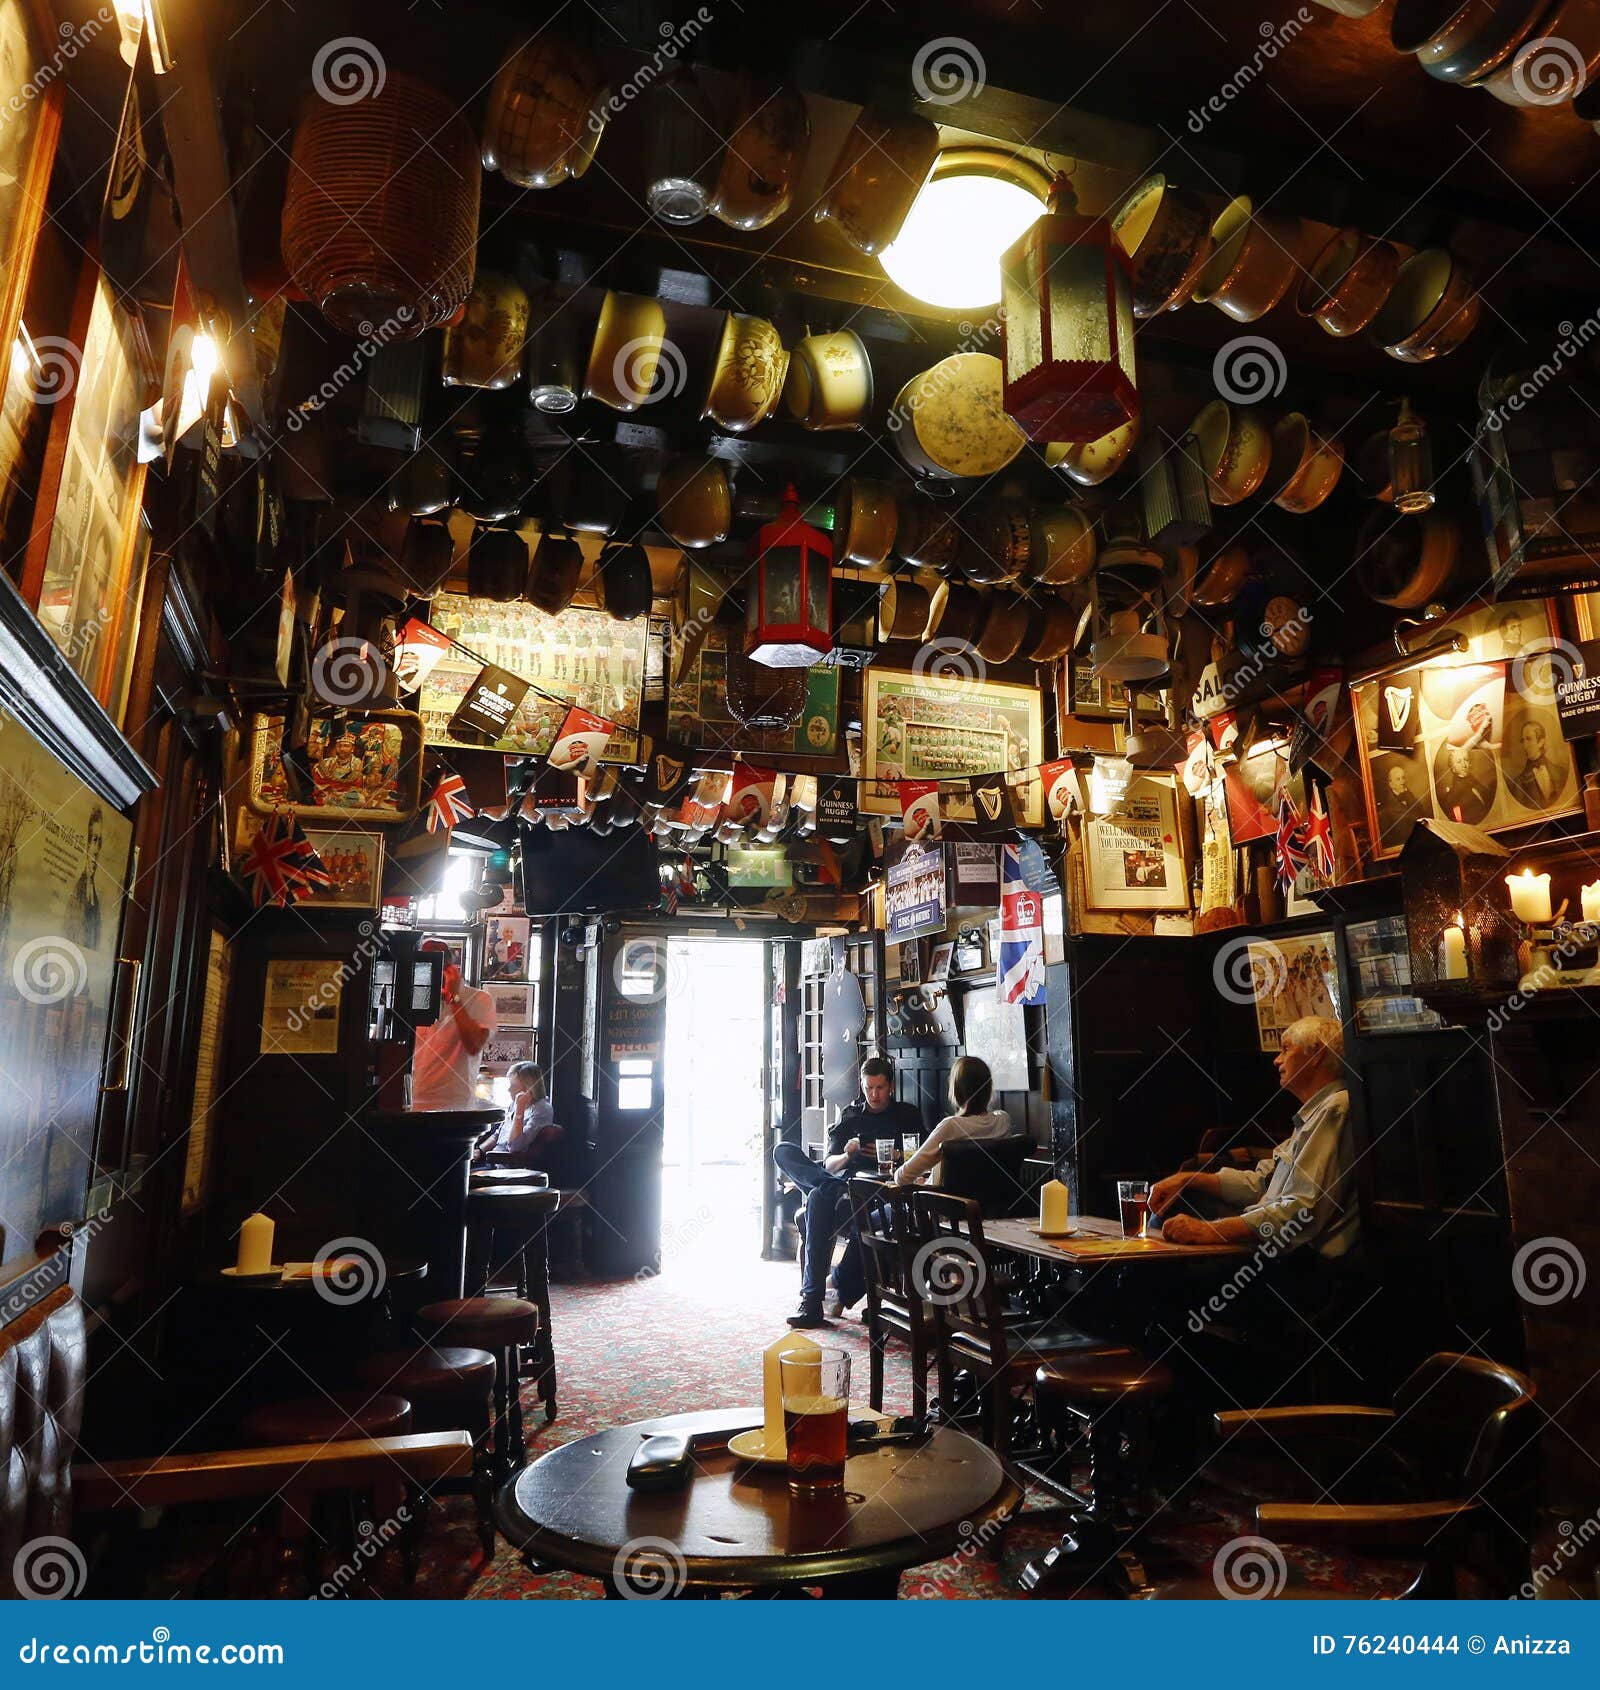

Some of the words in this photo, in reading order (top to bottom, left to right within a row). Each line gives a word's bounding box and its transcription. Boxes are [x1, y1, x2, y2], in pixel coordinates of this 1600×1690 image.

[1557, 676, 1600, 695] GUINNESS
[478, 686, 515, 711] GUINNESS
[1565, 689, 1596, 705] RUGBY
[479, 696, 507, 714] RUGBY
[1561, 709, 1577, 718] MADE
[1586, 704, 1600, 713] MOR
[820, 799, 854, 809] GUINNESS
[825, 808, 849, 816] RUGBY
[1099, 825, 1117, 837] WELL
[1120, 825, 1139, 837] DONE
[1140, 825, 1161, 838] GERRY
[1100, 837, 1113, 848] YOU
[1115, 837, 1144, 849] DESERVE
